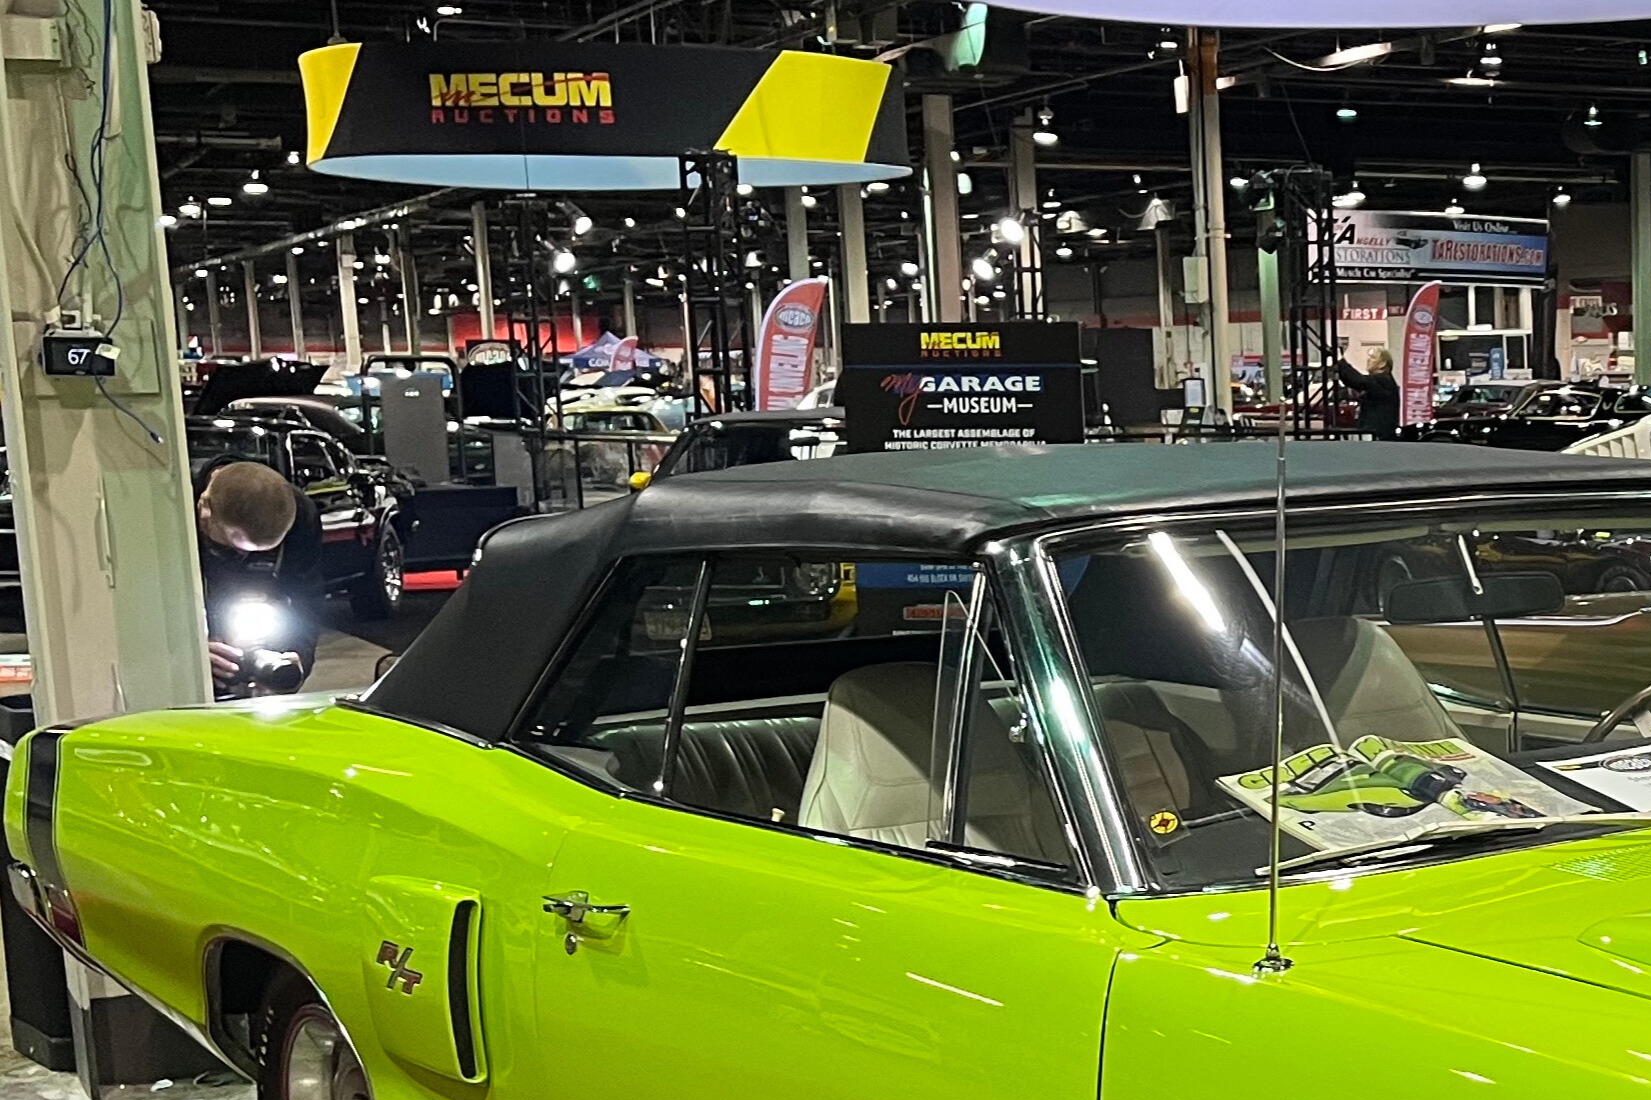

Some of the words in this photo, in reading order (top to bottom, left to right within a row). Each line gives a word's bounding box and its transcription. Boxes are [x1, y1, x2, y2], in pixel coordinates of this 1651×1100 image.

[429, 73, 612, 106] MECUM
[431, 109, 614, 123] AUCTIONS
[1335, 247, 1411, 263] STORATIONS
[1343, 308, 1378, 319] FIRST
[920, 333, 1001, 349] MECUM
[67, 348, 92, 365] 67
[920, 376, 1041, 391] GARAGE
[943, 397, 1017, 413] MUSEUM
[893, 429, 911, 438] THE
[913, 429, 955, 438] LARGEST
[957, 429, 1020, 438] ASSEMBLAGE
[1022, 429, 1036, 438] OF
[884, 441, 929, 450] HISTORIC
[376, 940, 423, 995] R/T
